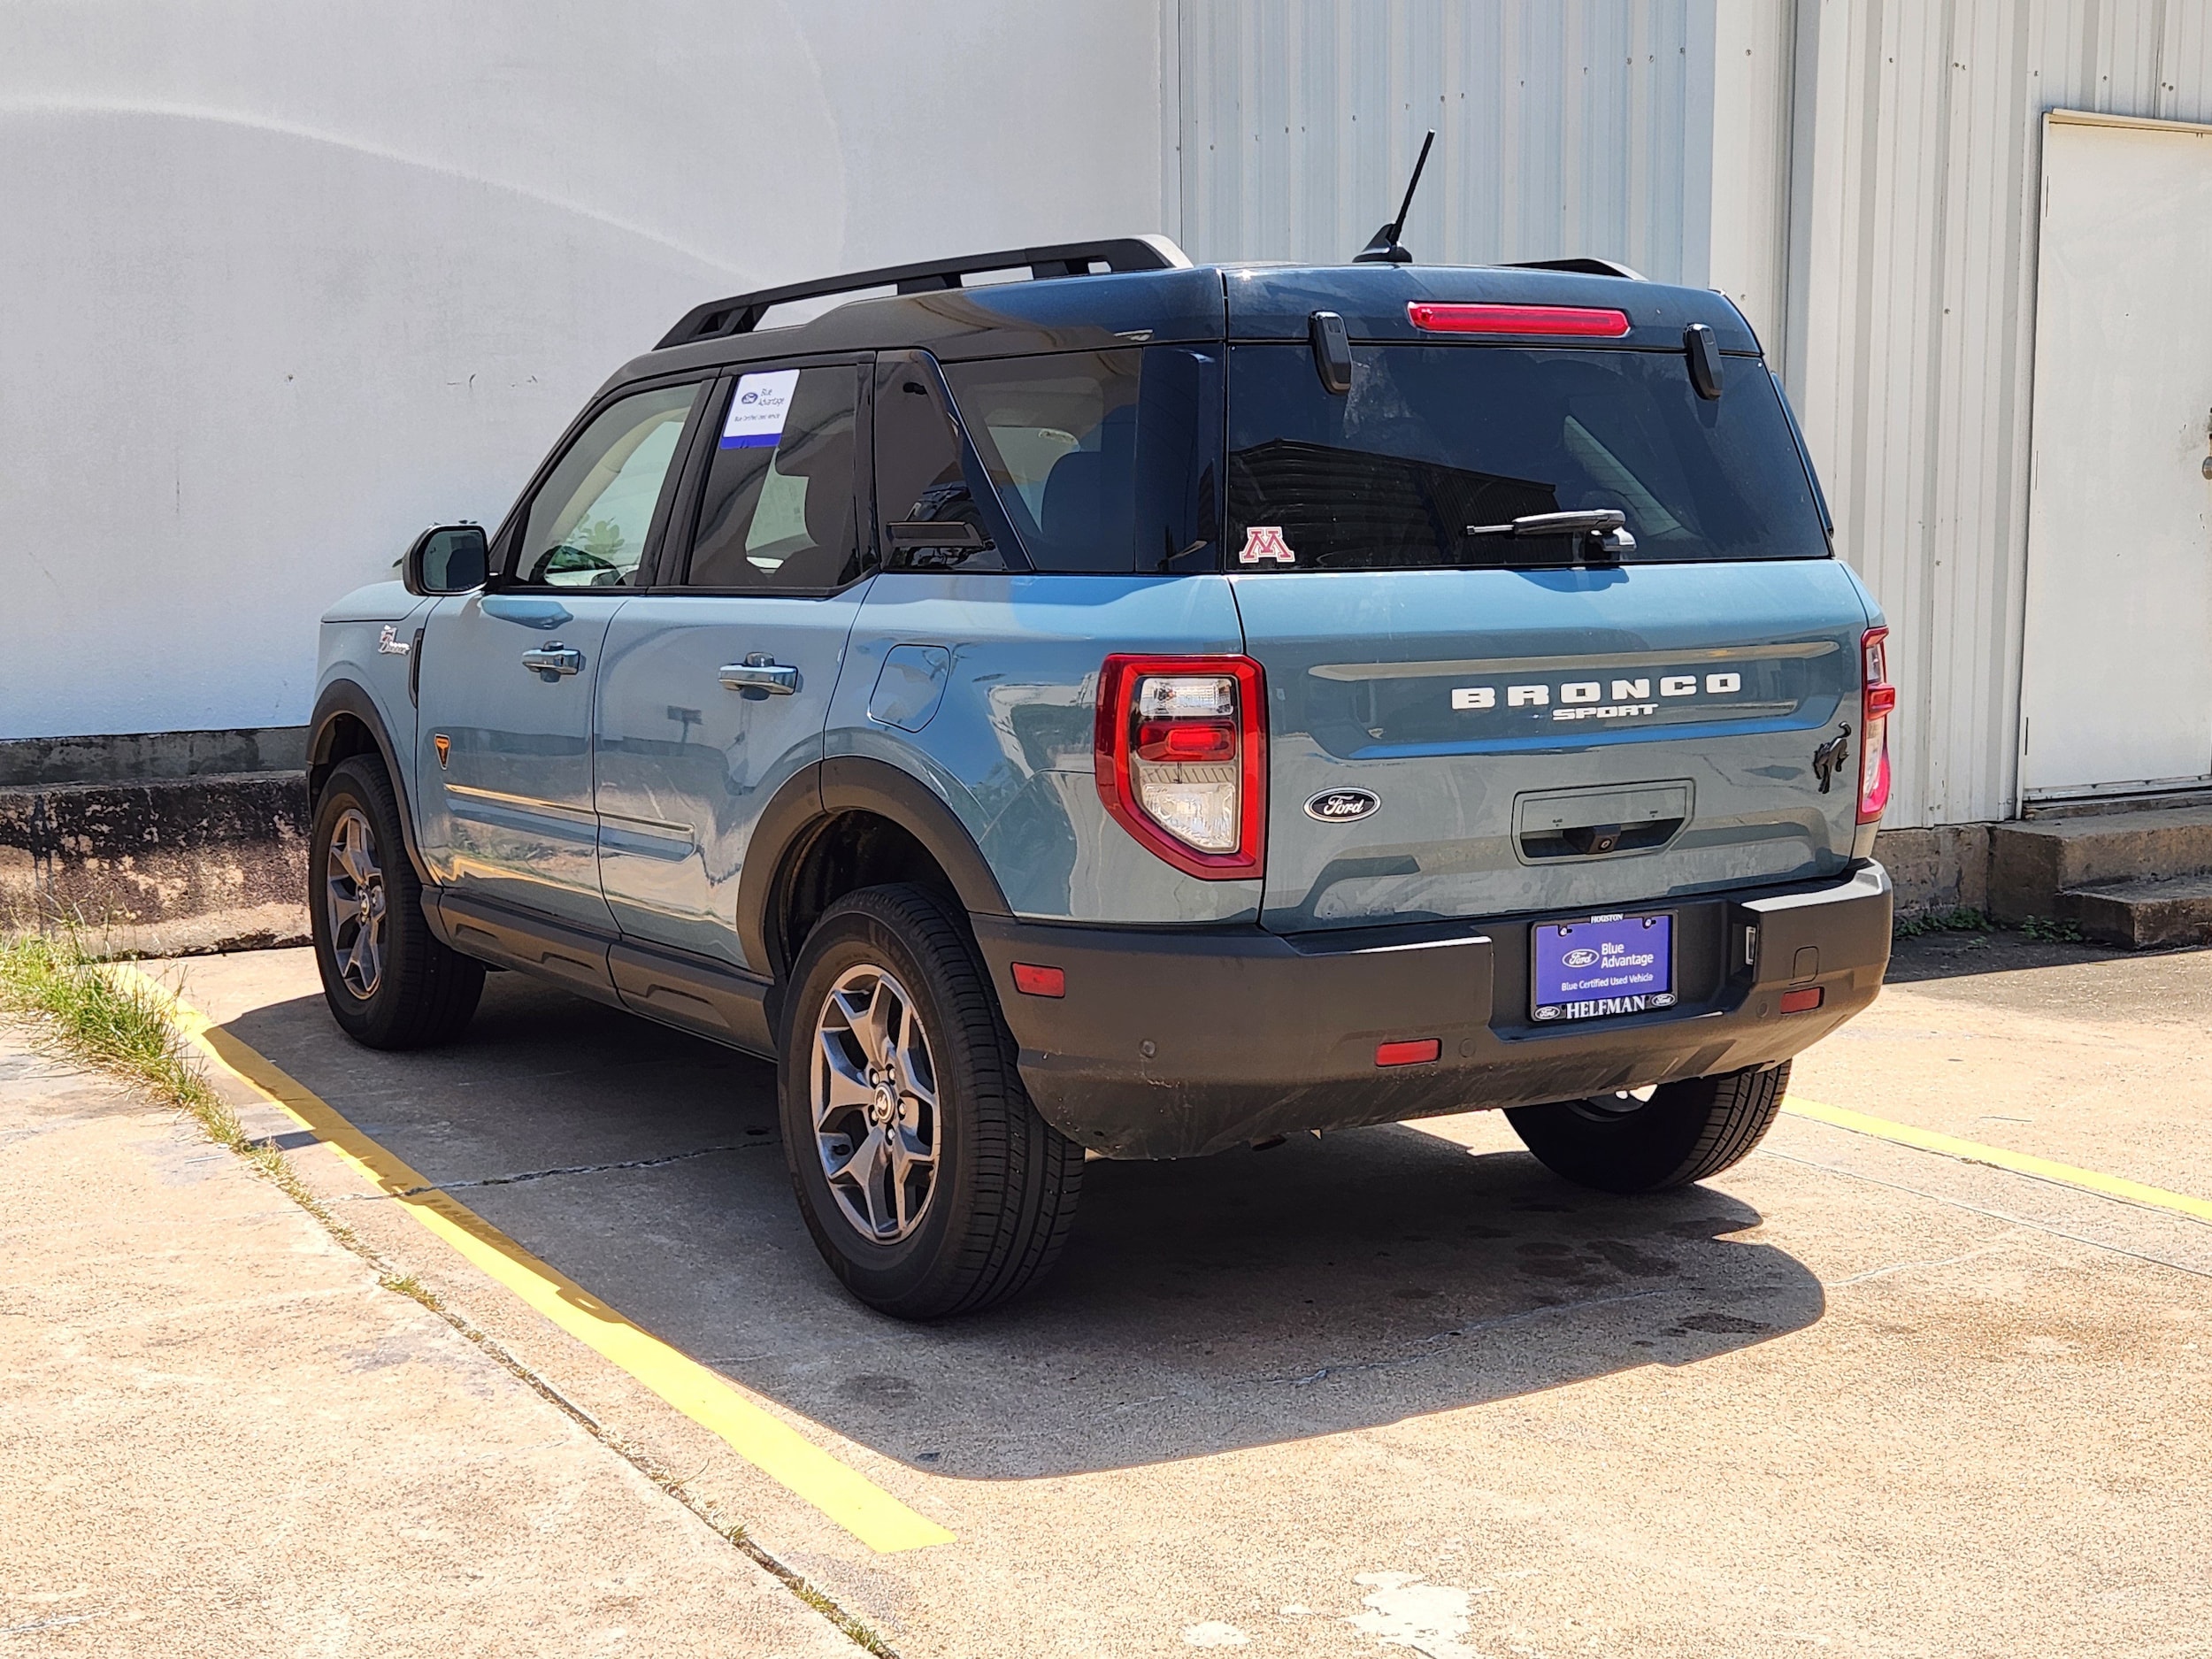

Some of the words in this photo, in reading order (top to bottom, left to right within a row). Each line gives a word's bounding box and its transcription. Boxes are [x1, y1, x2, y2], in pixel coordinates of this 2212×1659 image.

[1240, 528, 1294, 562] M
[1451, 672, 1740, 710] BRONCO
[1552, 703, 1659, 721] SPORT
[1323, 795, 1365, 816] Ford
[1591, 913, 1624, 924] HOUSTON
[1569, 952, 1593, 965] Ford
[1601, 942, 1624, 956] Blue
[1601, 954, 1654, 969] Advantage
[1562, 982, 1578, 992] Blue
[1579, 979, 1609, 989] Certified
[1610, 976, 1628, 986] Used
[1629, 972, 1654, 983] Vehicle
[1566, 995, 1647, 1019] HELFMAN
